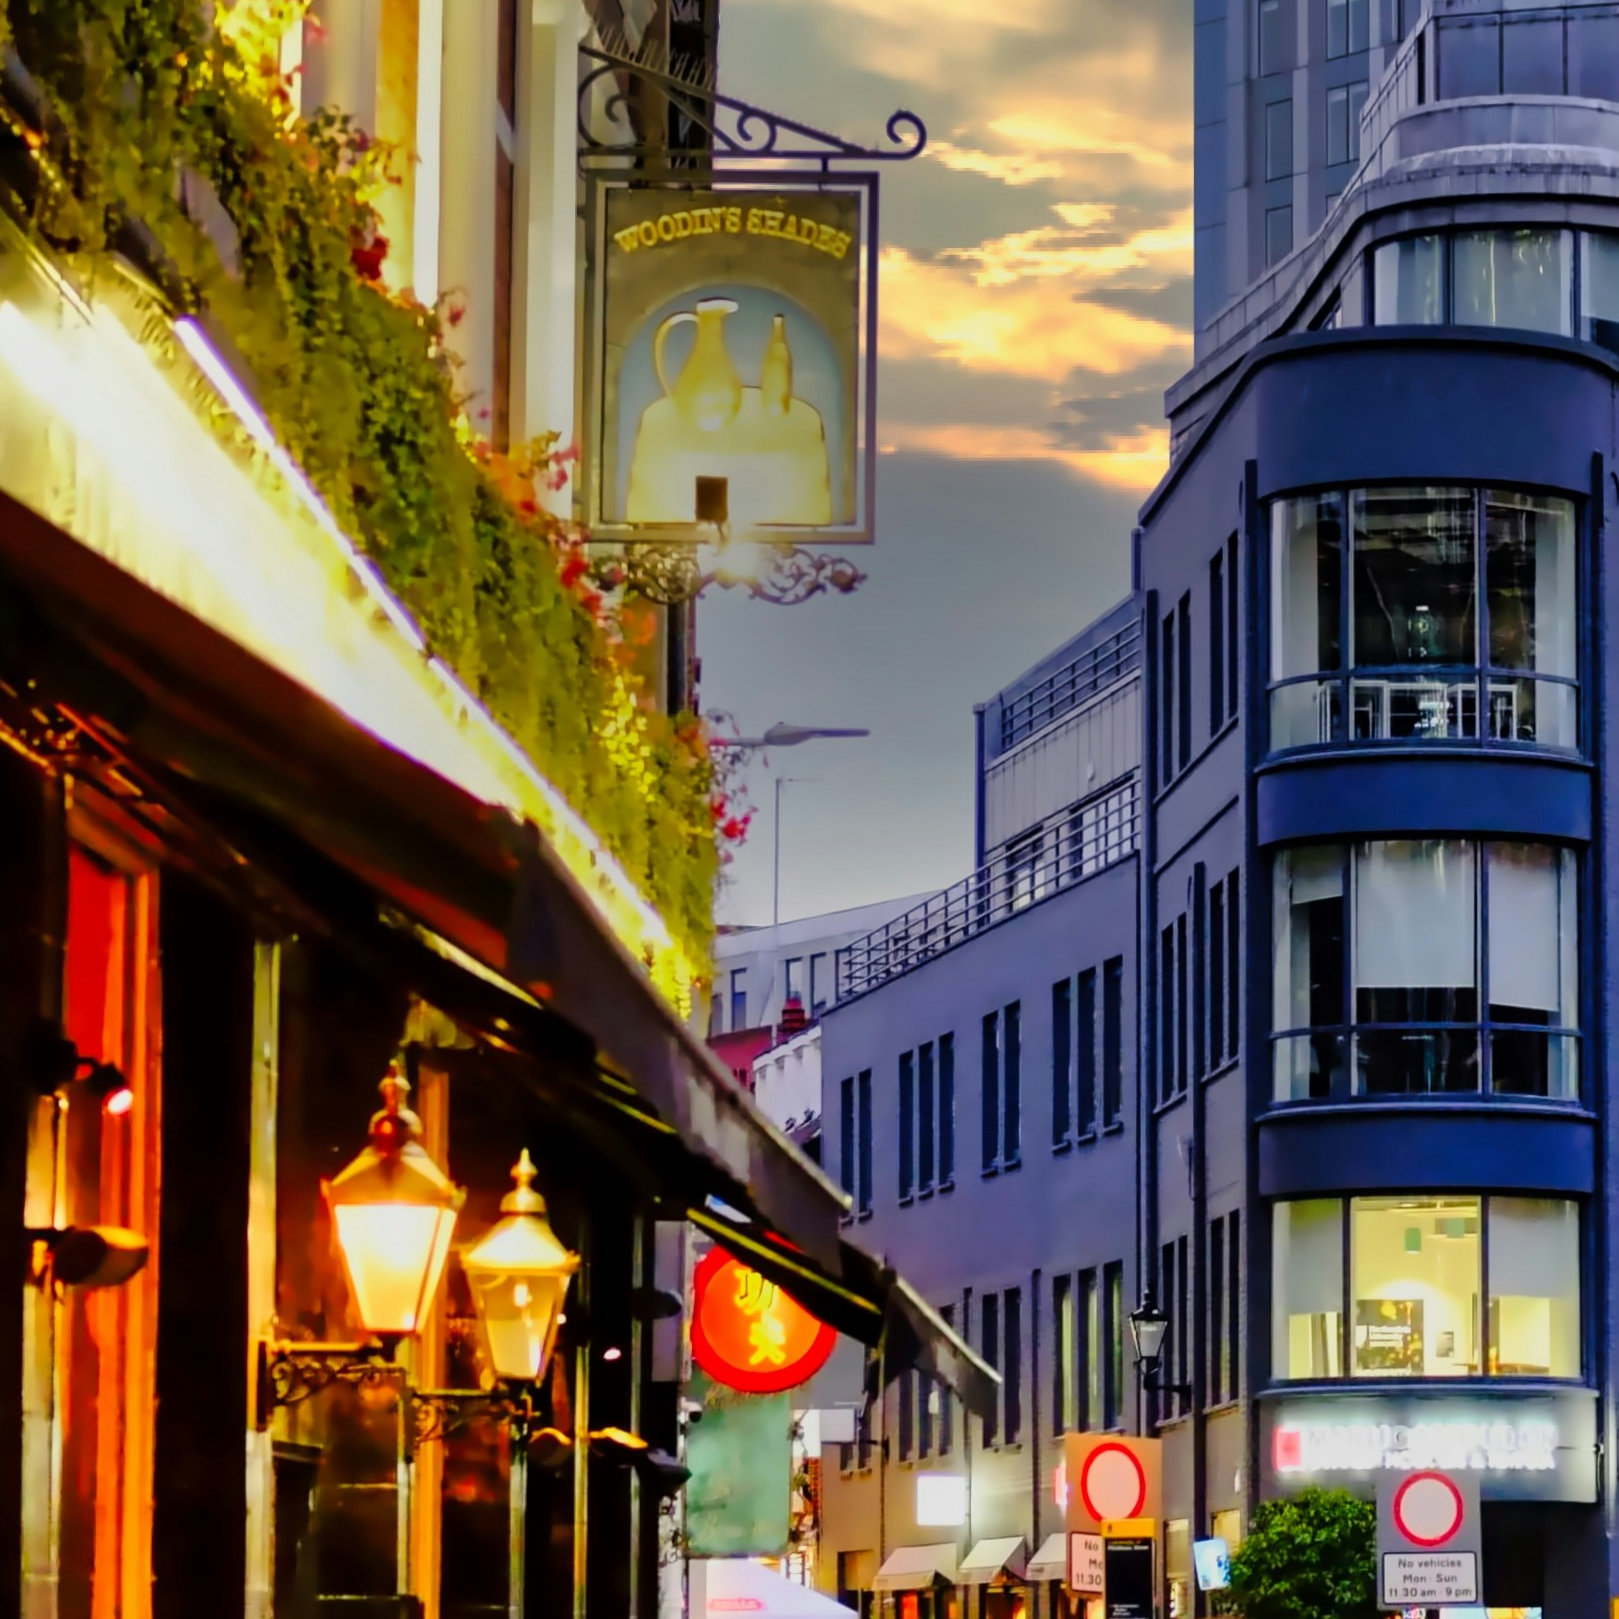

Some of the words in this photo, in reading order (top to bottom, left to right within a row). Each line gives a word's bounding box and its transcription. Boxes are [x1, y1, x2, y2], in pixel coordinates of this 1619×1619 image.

[614, 206, 742, 253] WOODIN'S
[746, 208, 852, 260] SHADES
[1084, 1540, 1099, 1551] No
[1397, 1558, 1415, 1569] No
[1417, 1557, 1463, 1569] vehicles
[1402, 1574, 1427, 1584] Mon
[1435, 1573, 1458, 1584] Sun
